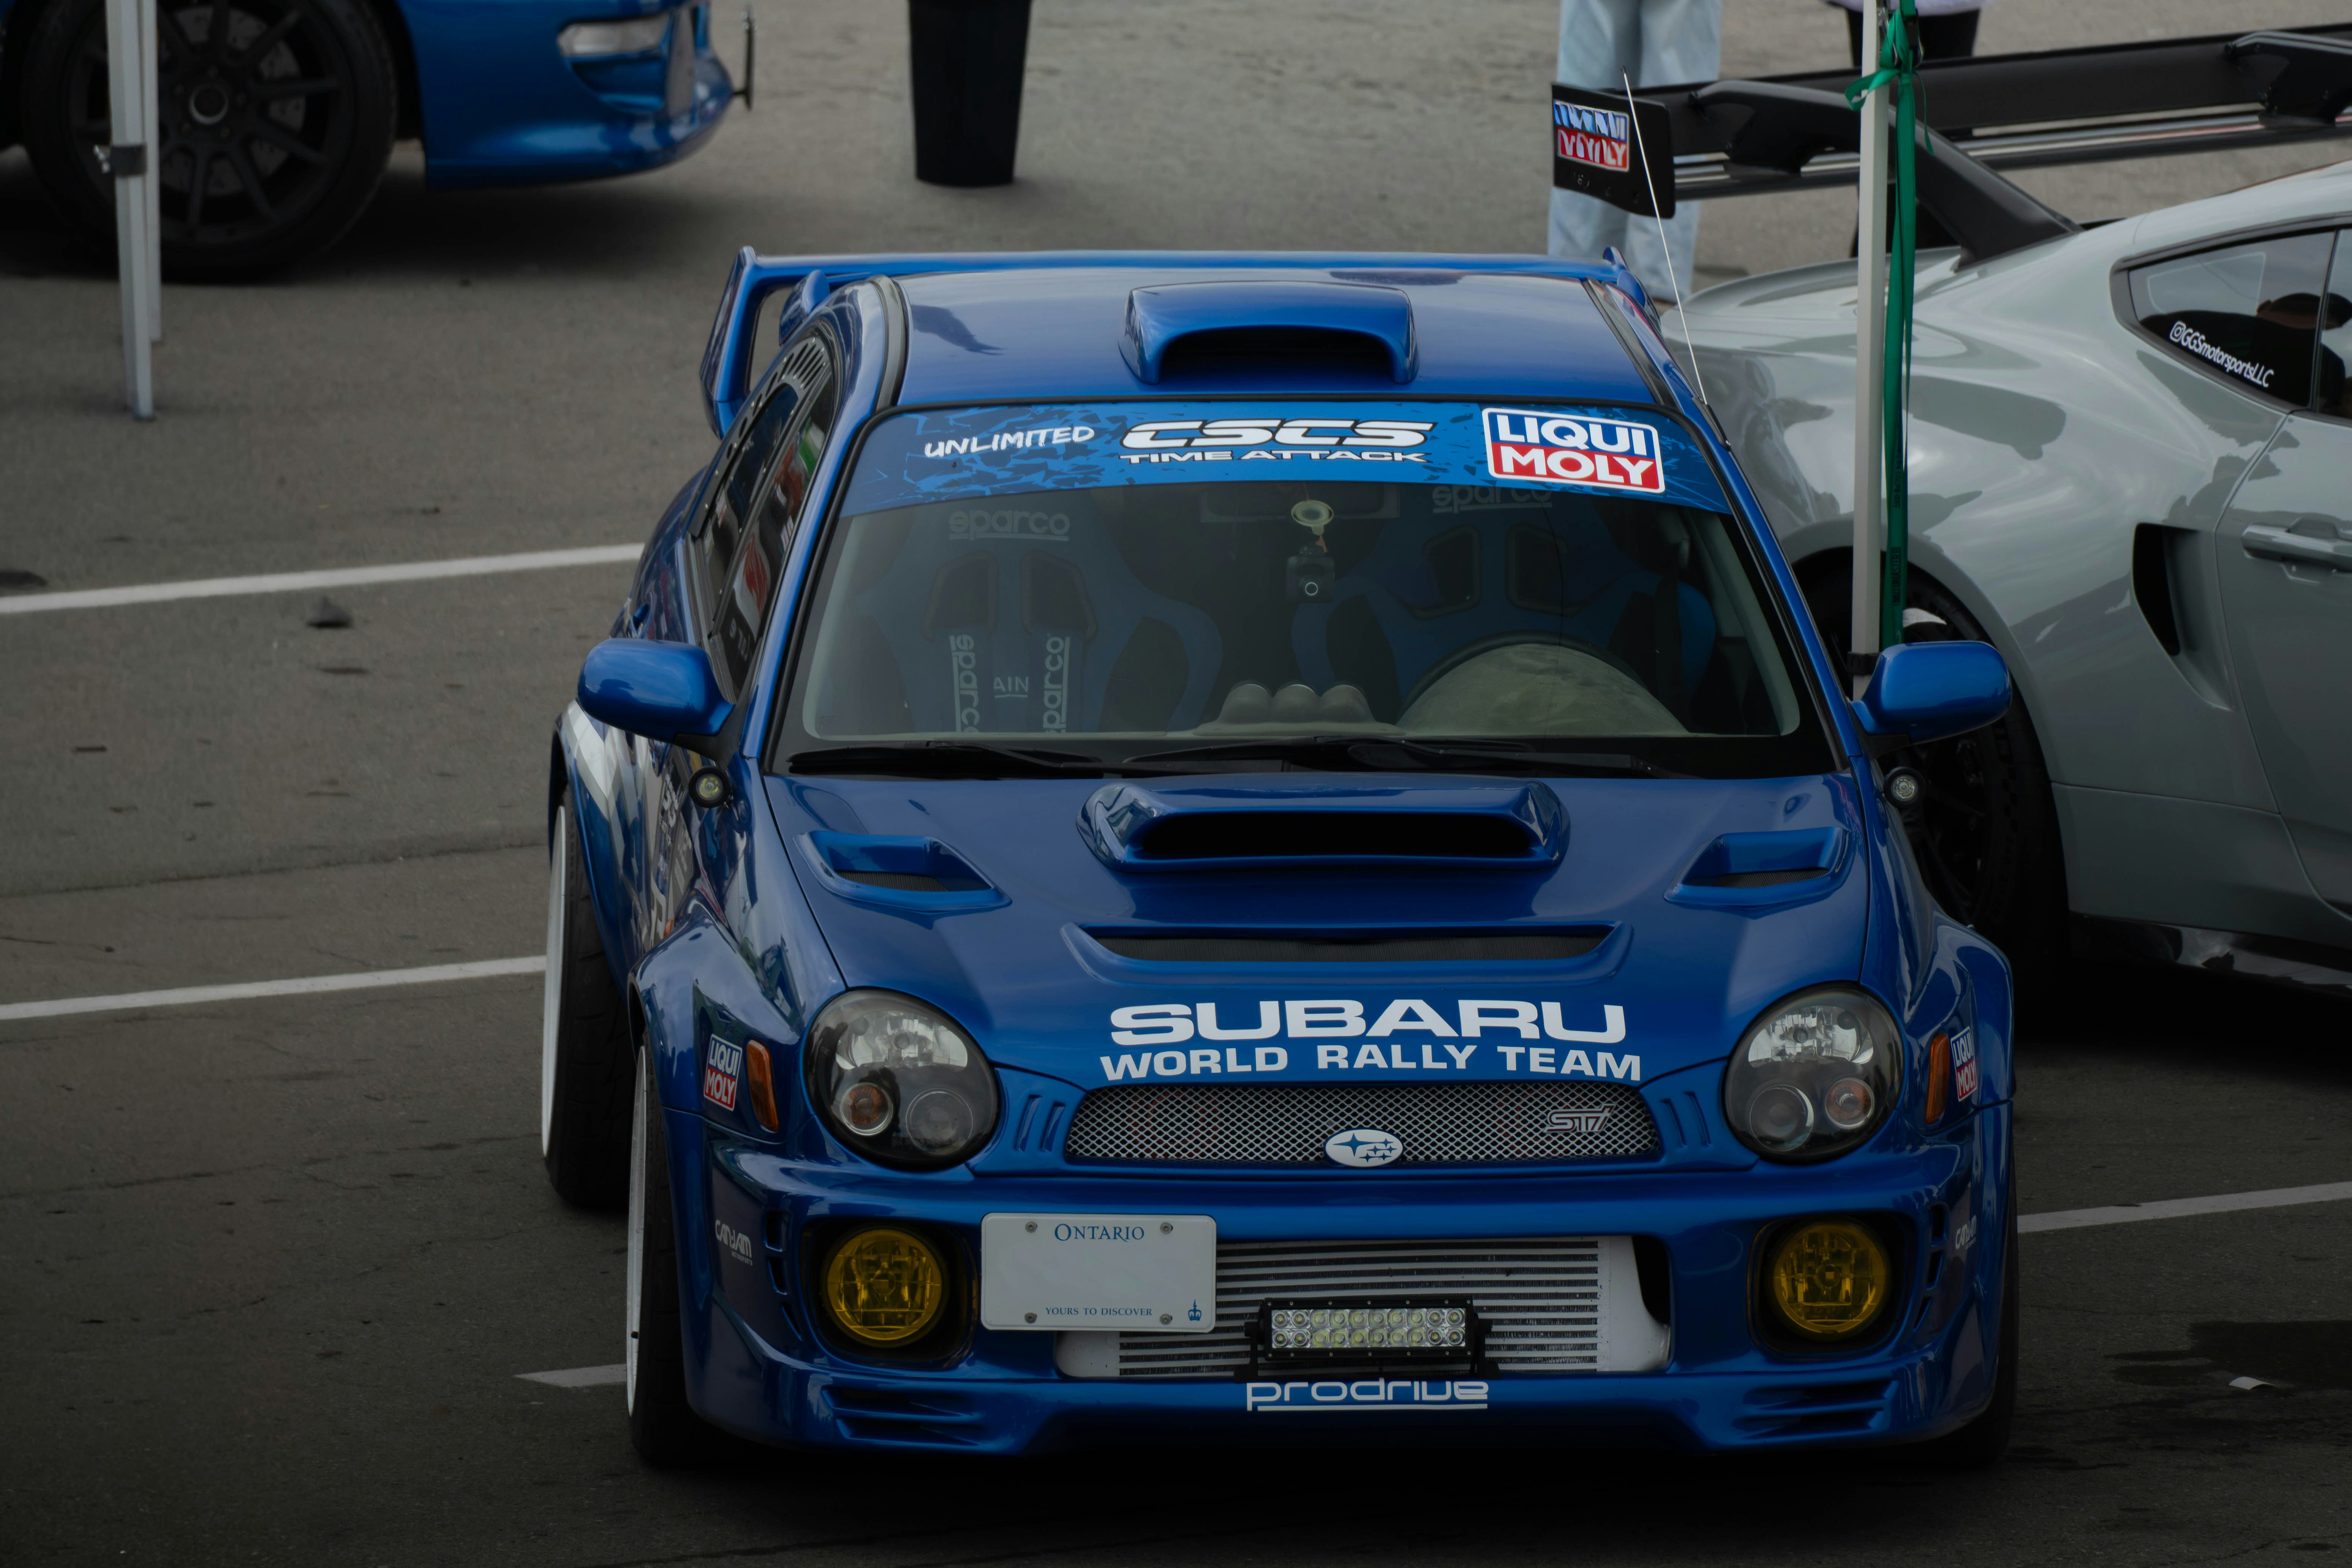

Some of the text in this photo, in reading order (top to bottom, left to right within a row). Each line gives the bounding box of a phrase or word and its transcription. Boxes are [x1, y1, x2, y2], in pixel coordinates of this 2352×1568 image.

[925, 426, 1094, 457] UNLIMITED
[1120, 418, 1438, 449] CSCS
[1497, 414, 1646, 456] LIQUI
[1118, 450, 1433, 464] TIME ATTACK
[1500, 446, 1654, 485] MOLY
[950, 510, 1070, 541] sparco
[1043, 636, 1070, 732] parco
[1110, 999, 1626, 1045] SUBARU
[709, 1040, 740, 1076] LIQUI
[1100, 1045, 1641, 1081] WORLD RALLY TEAM
[1952, 1035, 1973, 1064] LIQUI
[706, 1069, 736, 1104] MOLY
[1957, 1060, 1976, 1097] MOLY
[1543, 1103, 1616, 1133] STI
[1045, 1307, 1152, 1316] YOURS TO DISCOVER
[1247, 1378, 1489, 1411] prodrive
